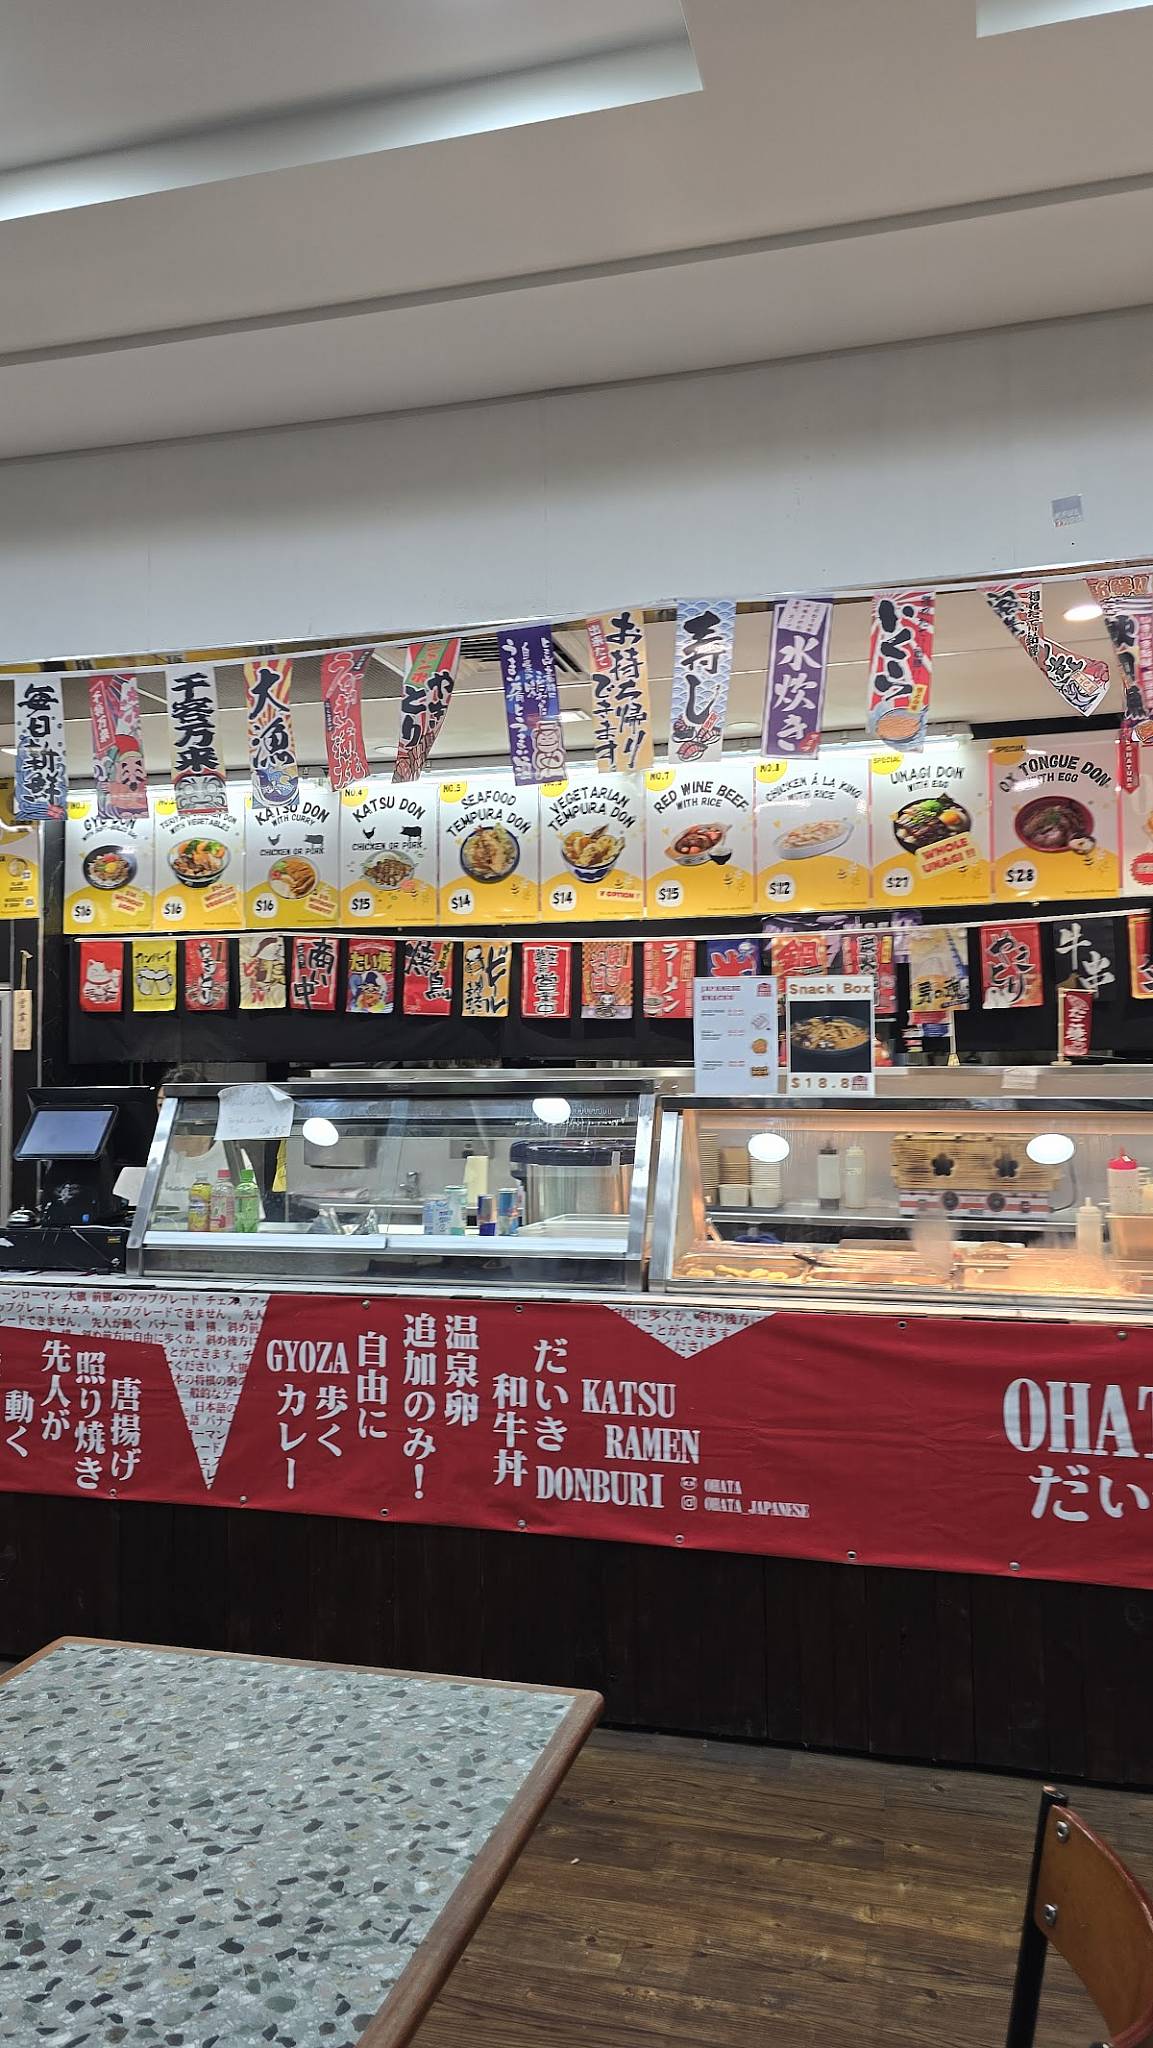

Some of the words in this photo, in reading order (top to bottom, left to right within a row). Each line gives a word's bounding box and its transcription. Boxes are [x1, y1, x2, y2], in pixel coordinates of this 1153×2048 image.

[681, 610, 727, 724] 寿し
[874, 600, 914, 702] いくら
[171, 672, 220, 773] 千客万来
[249, 668, 297, 769] 大漁
[607, 611, 648, 770] お持ち帰り
[774, 634, 824, 752] 水炊き
[18, 683, 62, 804] 毎日新鮮
[935, 765, 966, 780] DON
[1018, 755, 1080, 777] TONGUE
[1080, 761, 1112, 788] DON
[302, 802, 331, 823] DON
[352, 796, 395, 823] KATSU
[399, 798, 427, 820] DON
[446, 808, 505, 837] TEMPURA
[506, 811, 532, 834] DON
[461, 790, 517, 810] SEAFOOD
[547, 801, 607, 831] TEMPURA
[610, 806, 636, 829] DON
[549, 785, 631, 815] VEGETARIAN
[653, 790, 678, 815] RED
[681, 779, 714, 796] WINE
[717, 784, 750, 811] BEEF
[701, 797, 722, 808] RICE
[661, 942, 682, 1014] ラーメン
[788, 983, 835, 995] Snack
[843, 983, 872, 994] Box
[41, 1338, 71, 1442] 先人が
[265, 1339, 351, 1375] GYOZA
[356, 1330, 389, 1440] 自由に
[443, 1314, 479, 1428] 温泉卵
[4, 1389, 36, 1459] 動く
[76, 1350, 107, 1490] 照り焼き
[110, 1376, 143, 1481] 唐揚げ
[316, 1384, 349, 1458] 歩く
[492, 1372, 529, 1488] 和牛丼
[533, 1338, 570, 1452] だいき
[581, 1378, 677, 1419] KATSU
[276, 1383, 307, 1490] カレー
[603, 1424, 702, 1466] RAMEN
[535, 1464, 666, 1509] DONBURI
